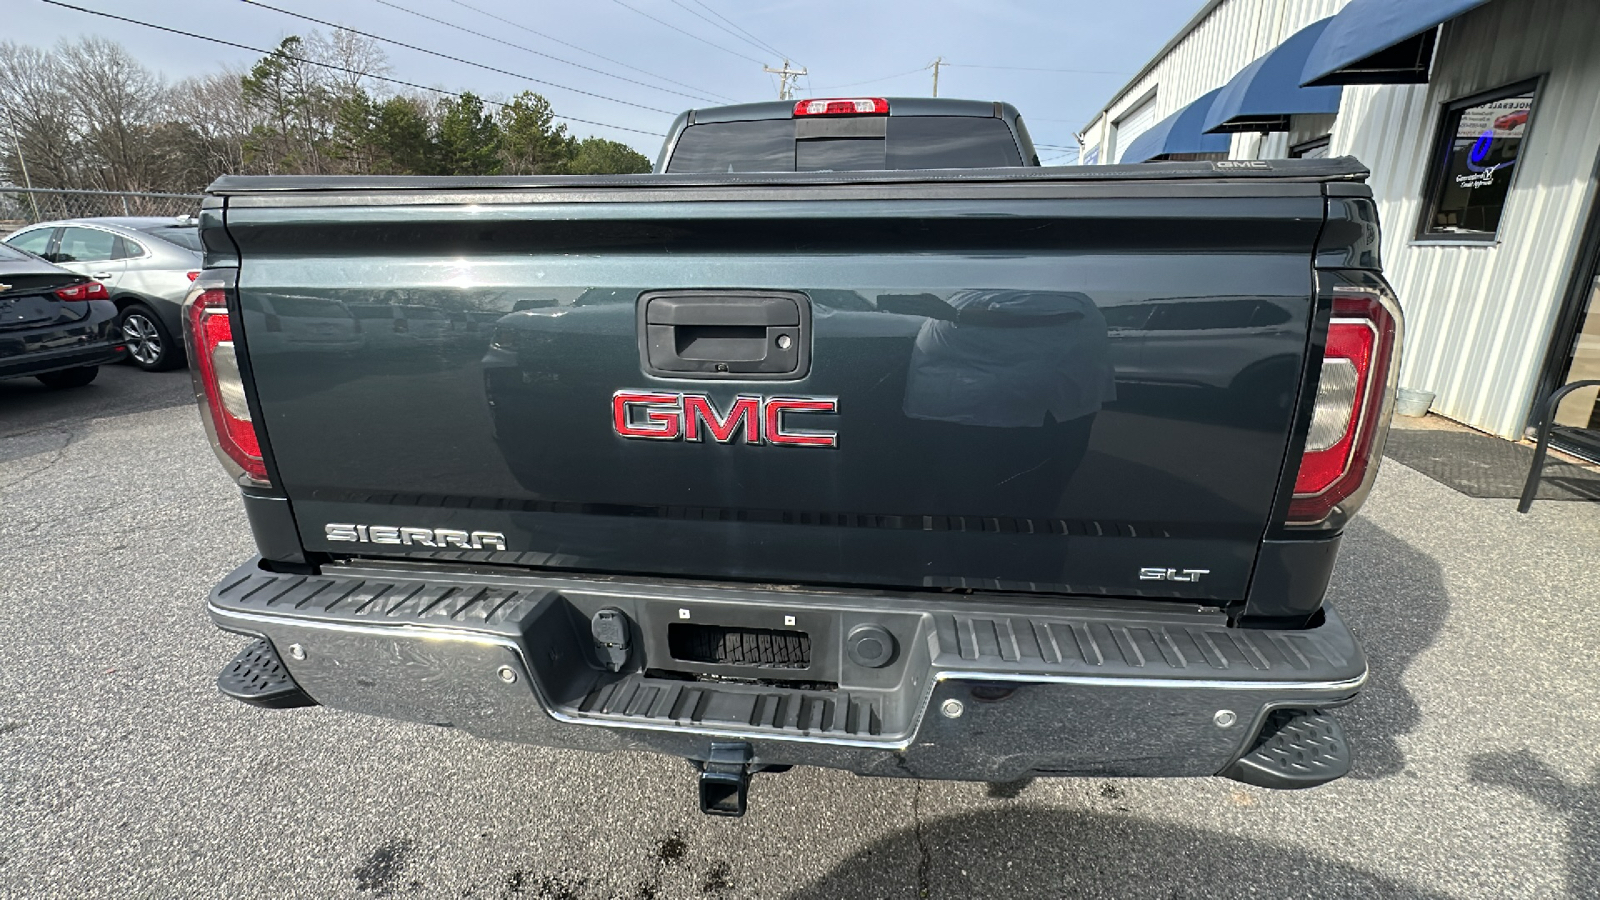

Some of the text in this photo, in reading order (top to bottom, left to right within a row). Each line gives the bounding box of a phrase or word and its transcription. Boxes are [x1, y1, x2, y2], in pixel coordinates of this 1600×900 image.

[612, 389, 838, 447] GMC
[324, 523, 506, 551] SIERRA
[1139, 567, 1210, 582] SLT
